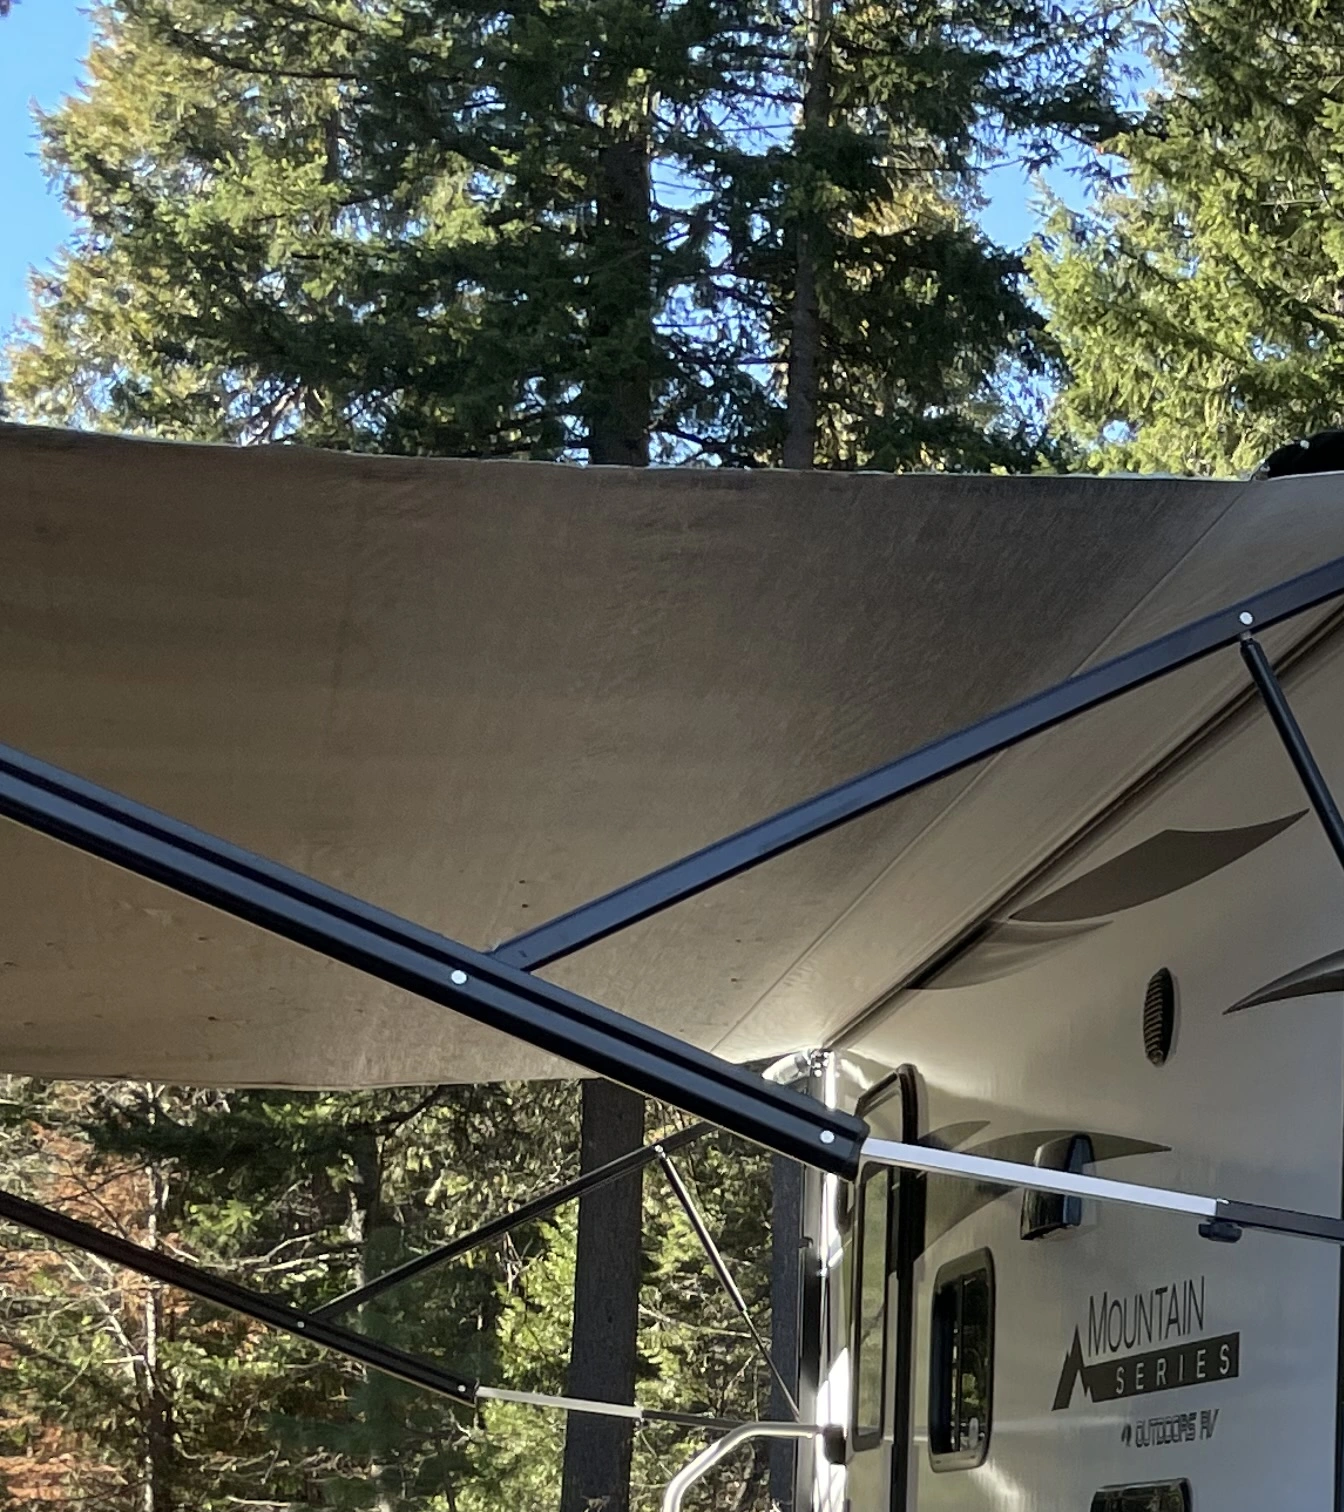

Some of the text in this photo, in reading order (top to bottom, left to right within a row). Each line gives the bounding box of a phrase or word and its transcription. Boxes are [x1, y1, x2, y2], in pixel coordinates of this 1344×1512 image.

[1088, 1275, 1205, 1357] MOUNTAIN
[1116, 1343, 1230, 1395] SERIES
[1136, 1409, 1220, 1448] OUTDOORS RV
